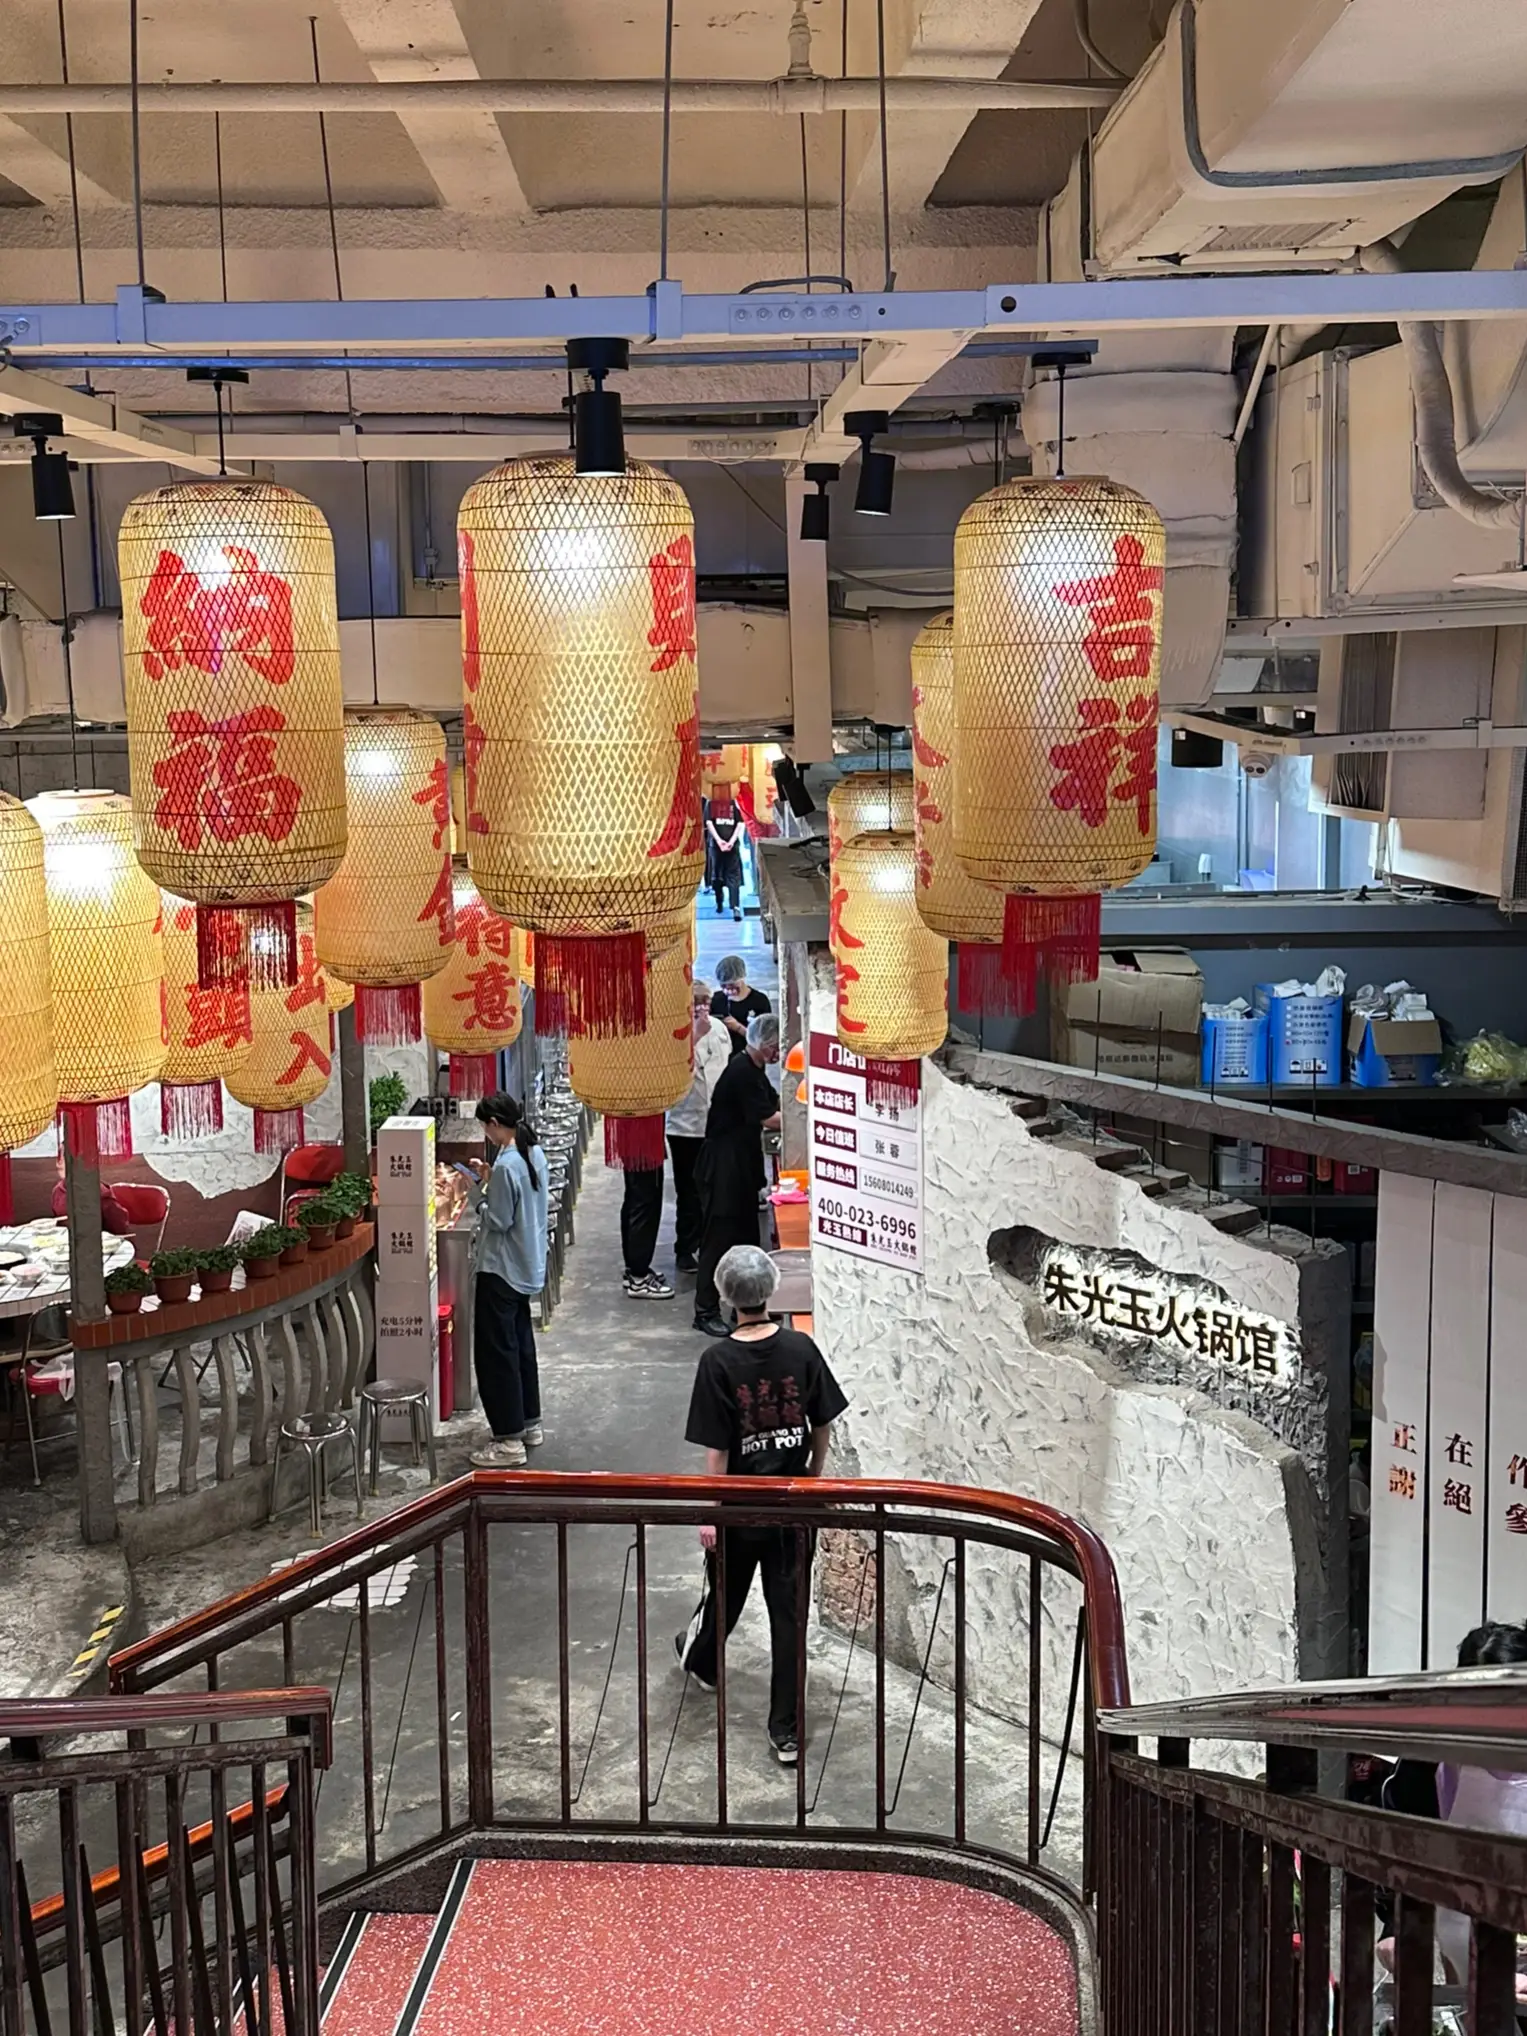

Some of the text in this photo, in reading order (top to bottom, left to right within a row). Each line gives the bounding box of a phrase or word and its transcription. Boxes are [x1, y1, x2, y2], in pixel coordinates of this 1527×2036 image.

[1050, 535, 1163, 836] 吉祥
[816, 1125, 855, 1149] 今日值班
[818, 1197, 916, 1240] 400-023-6996
[1045, 1263, 1278, 1375] 朱光玉火锅馆
[741, 1435, 804, 1455] HOT POT
